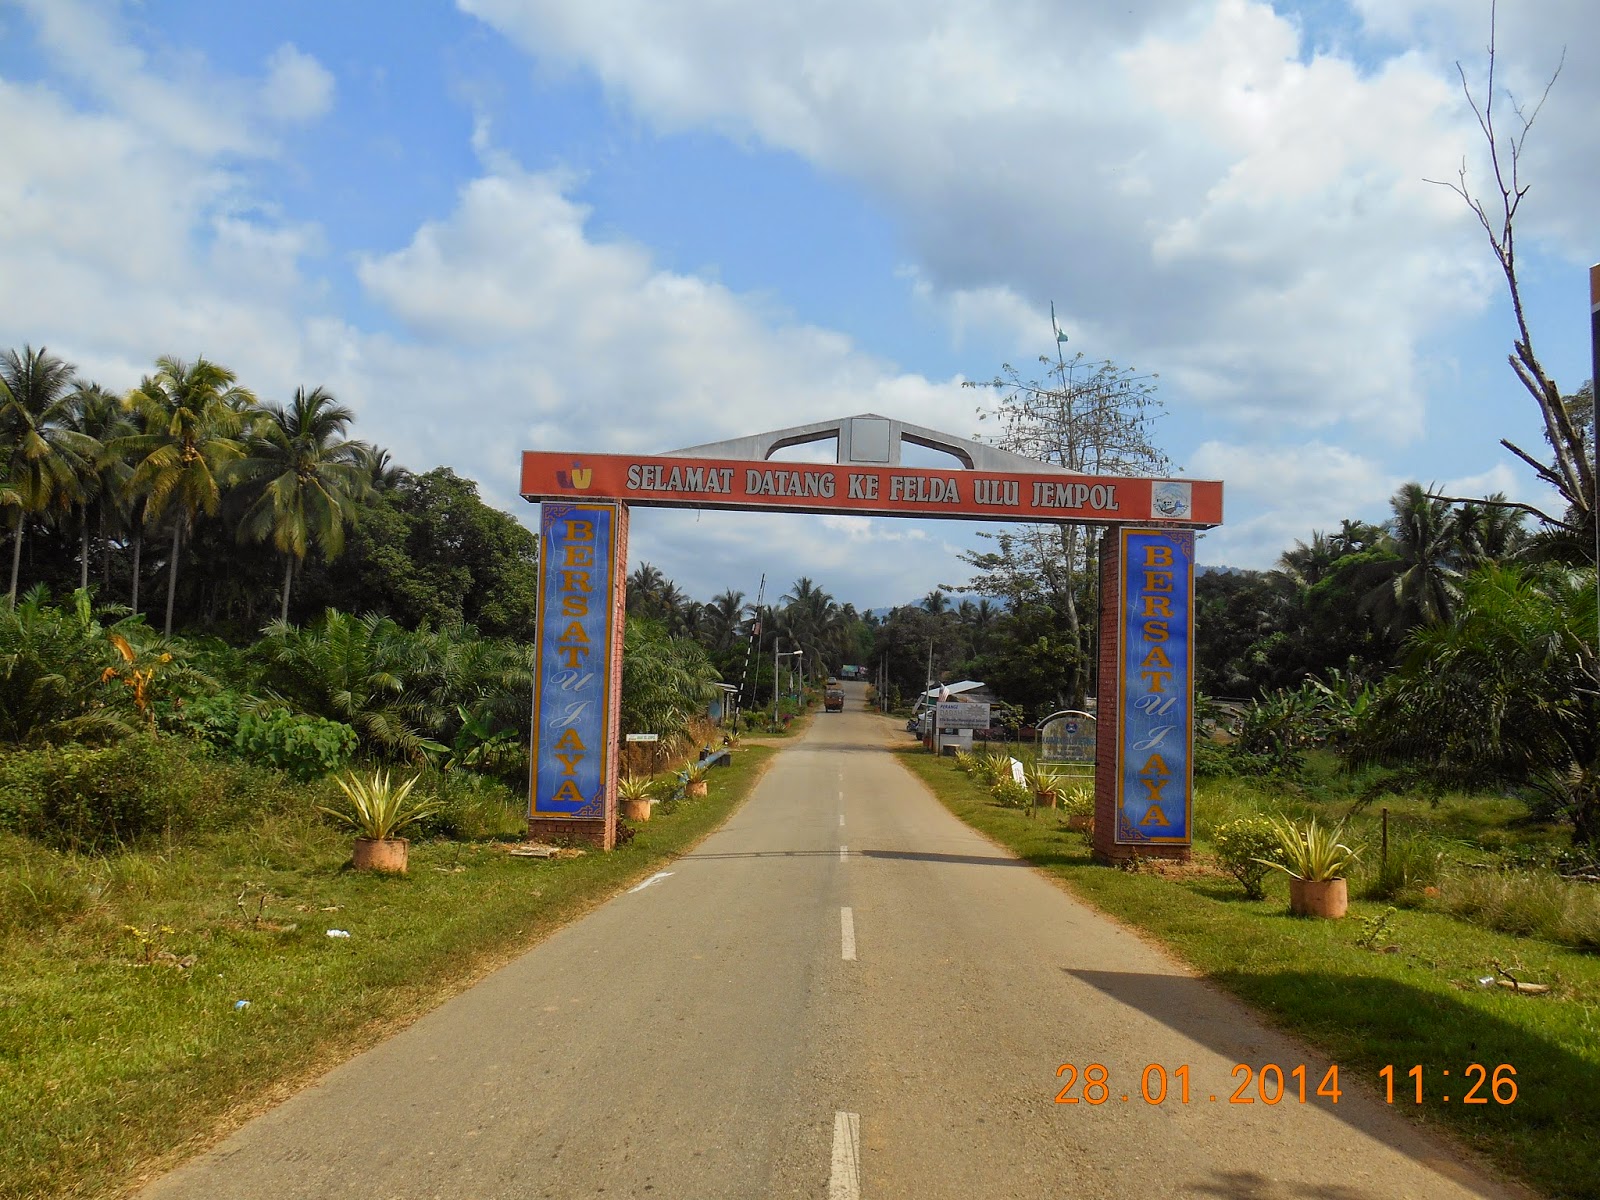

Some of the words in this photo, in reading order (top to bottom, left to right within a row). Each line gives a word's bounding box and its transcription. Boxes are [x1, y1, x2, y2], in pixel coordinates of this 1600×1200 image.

[626, 464, 734, 494] SELAMAT
[745, 469, 836, 498] DATANG
[847, 474, 879, 500] KE
[889, 475, 960, 504] FELDA
[973, 479, 1020, 506] ULU
[1031, 481, 1119, 511] JEMPOL
